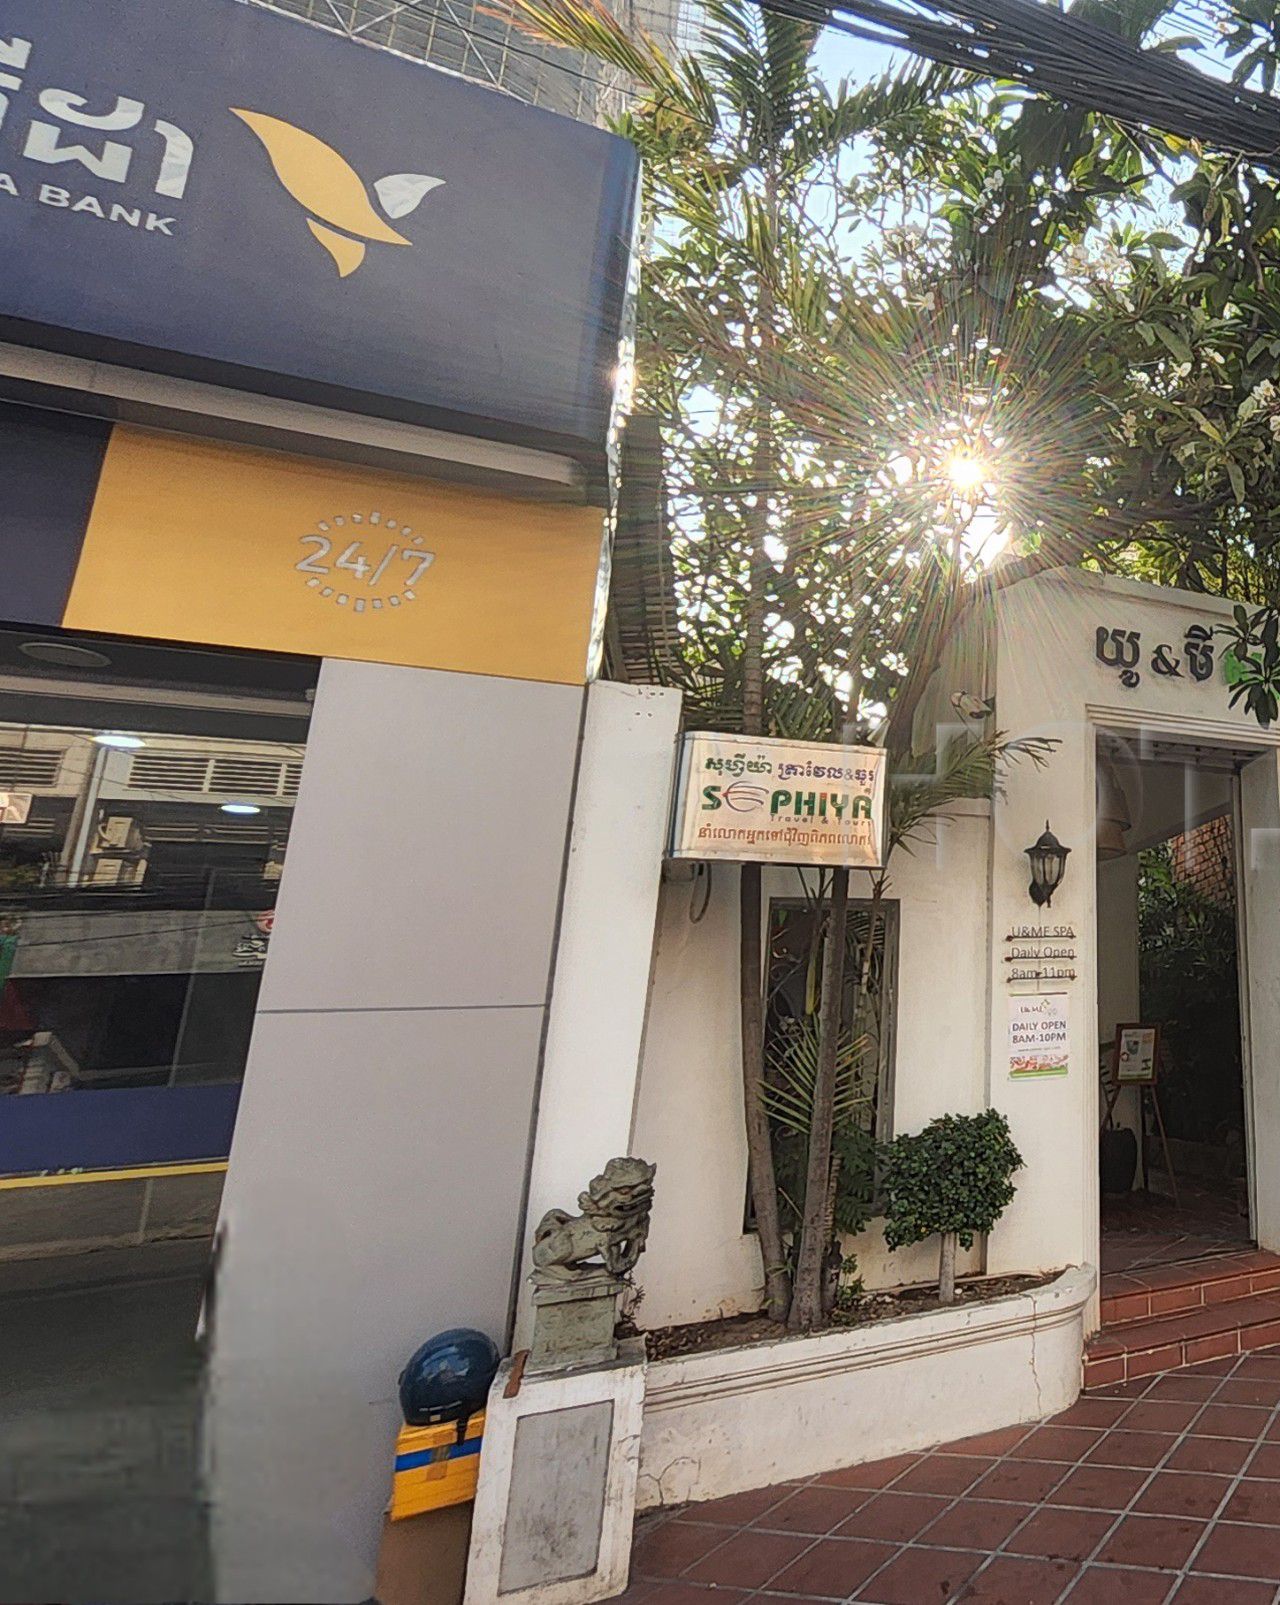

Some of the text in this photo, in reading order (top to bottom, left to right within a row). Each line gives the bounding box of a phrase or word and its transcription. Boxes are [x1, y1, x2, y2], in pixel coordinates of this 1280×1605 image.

[39, 184, 177, 236] BANK
[295, 533, 436, 588] 24/7
[1054, 926, 1075, 938] SPA
[1012, 946, 1075, 959] Daily Open
[1012, 1020, 1067, 1032] DAILY OPEN
[1012, 1032, 1067, 1044] 8AM-10PM
